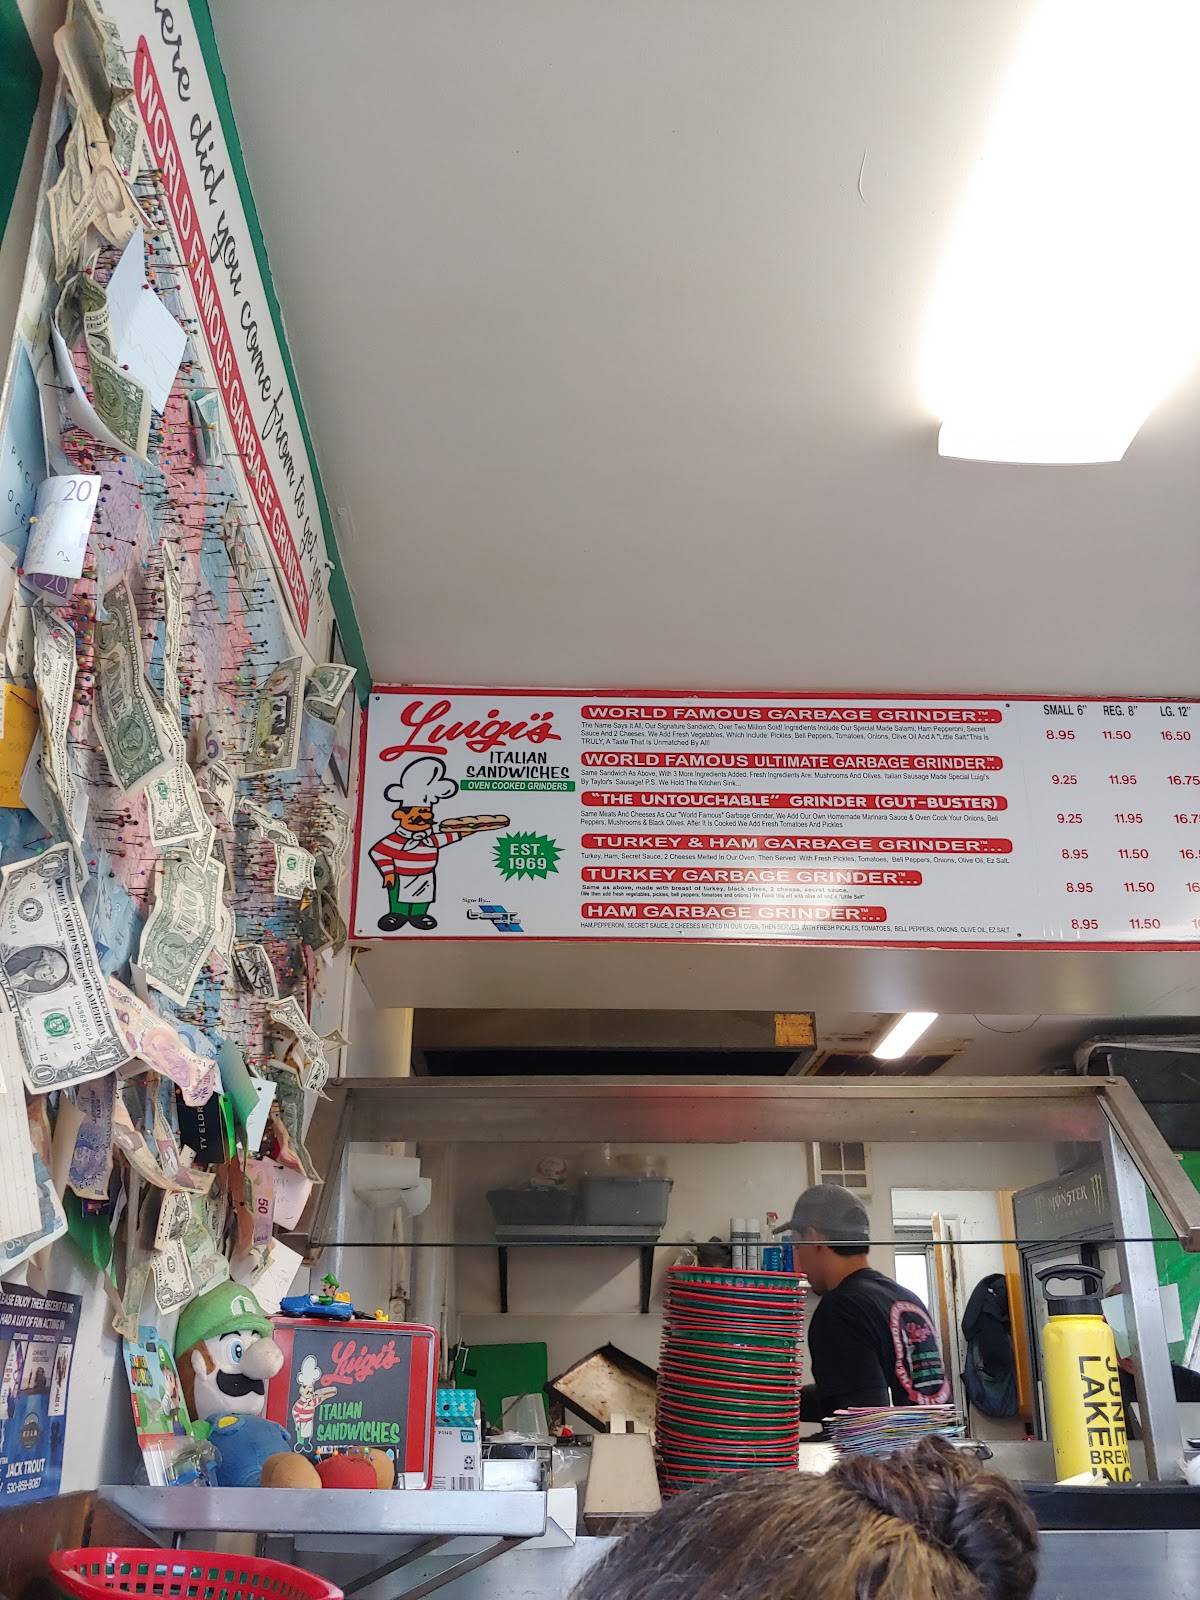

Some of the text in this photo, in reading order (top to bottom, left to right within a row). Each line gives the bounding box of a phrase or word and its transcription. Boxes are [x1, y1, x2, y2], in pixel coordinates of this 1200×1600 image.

[138, 57, 196, 240] WORLD
[188, 238, 232, 381] FAMOUS
[230, 379, 274, 520] GARBAGE
[191, 113, 224, 205] did
[210, 212, 242, 297] you
[243, 300, 272, 399] come
[262, 388, 296, 485] from
[294, 474, 305, 518] to
[300, 516, 318, 562] get
[62, 480, 92, 502] 20
[44, 576, 69, 594] 20
[588, 707, 667, 718] WORLD
[674, 708, 762, 719] FAMOUS
[768, 709, 871, 720] GARBAGE
[1043, 705, 1074, 715] SMALL
[1103, 705, 1125, 716] REG.
[1160, 706, 1175, 717] LG.
[378, 700, 561, 762] Luigi's
[1046, 730, 1075, 740] 8.95
[1102, 730, 1131, 740] 11.50
[1160, 731, 1191, 741] 16.50
[490, 751, 548, 764] ITALIAN
[585, 754, 659, 766] WORLD
[665, 754, 748, 767] FAMOUS
[754, 756, 828, 768] ULTIMATE
[833, 757, 909, 768] GARBAGE
[466, 765, 570, 780] SANDWICHES
[1051, 775, 1077, 785] 9.25
[1108, 775, 1137, 785] 11.95
[468, 782, 568, 791] OVEN COOKED GRINDERS
[592, 793, 997, 809] "THE UNTOUCHABLE" GRINDER (GUT-BUSTER)
[1057, 813, 1083, 824] 9.25
[1115, 813, 1143, 824] 11.95
[593, 837, 682, 848] TURKEY
[688, 837, 703, 848] &
[710, 838, 757, 848] HAM
[764, 838, 871, 849] GARBAGE
[510, 843, 544, 856] EST.
[1062, 849, 1089, 859] 8.95
[1118, 849, 1149, 859] 11.50
[508, 857, 547, 870] 1969
[587, 869, 676, 880] TURKEY
[682, 870, 788, 881] GARBAGE
[1066, 883, 1093, 893] 8.95
[1124, 883, 1155, 893] 11.50
[588, 905, 636, 916] HAM
[643, 906, 750, 917] GARBAGE
[1071, 919, 1098, 930] 8.95
[1129, 919, 1161, 930] 11.50
[87, 992, 106, 1036] AMERICA
[258, 1198, 268, 1214] 50
[320, 1340, 400, 1386] Luigi's
[1078, 1356, 1112, 1447] LAKE
[319, 1401, 362, 1421] ITALIAN
[316, 1421, 400, 1444] SANDWICHES
[6, 1461, 23, 1478] JACK
[24, 1458, 46, 1474] TROUT
